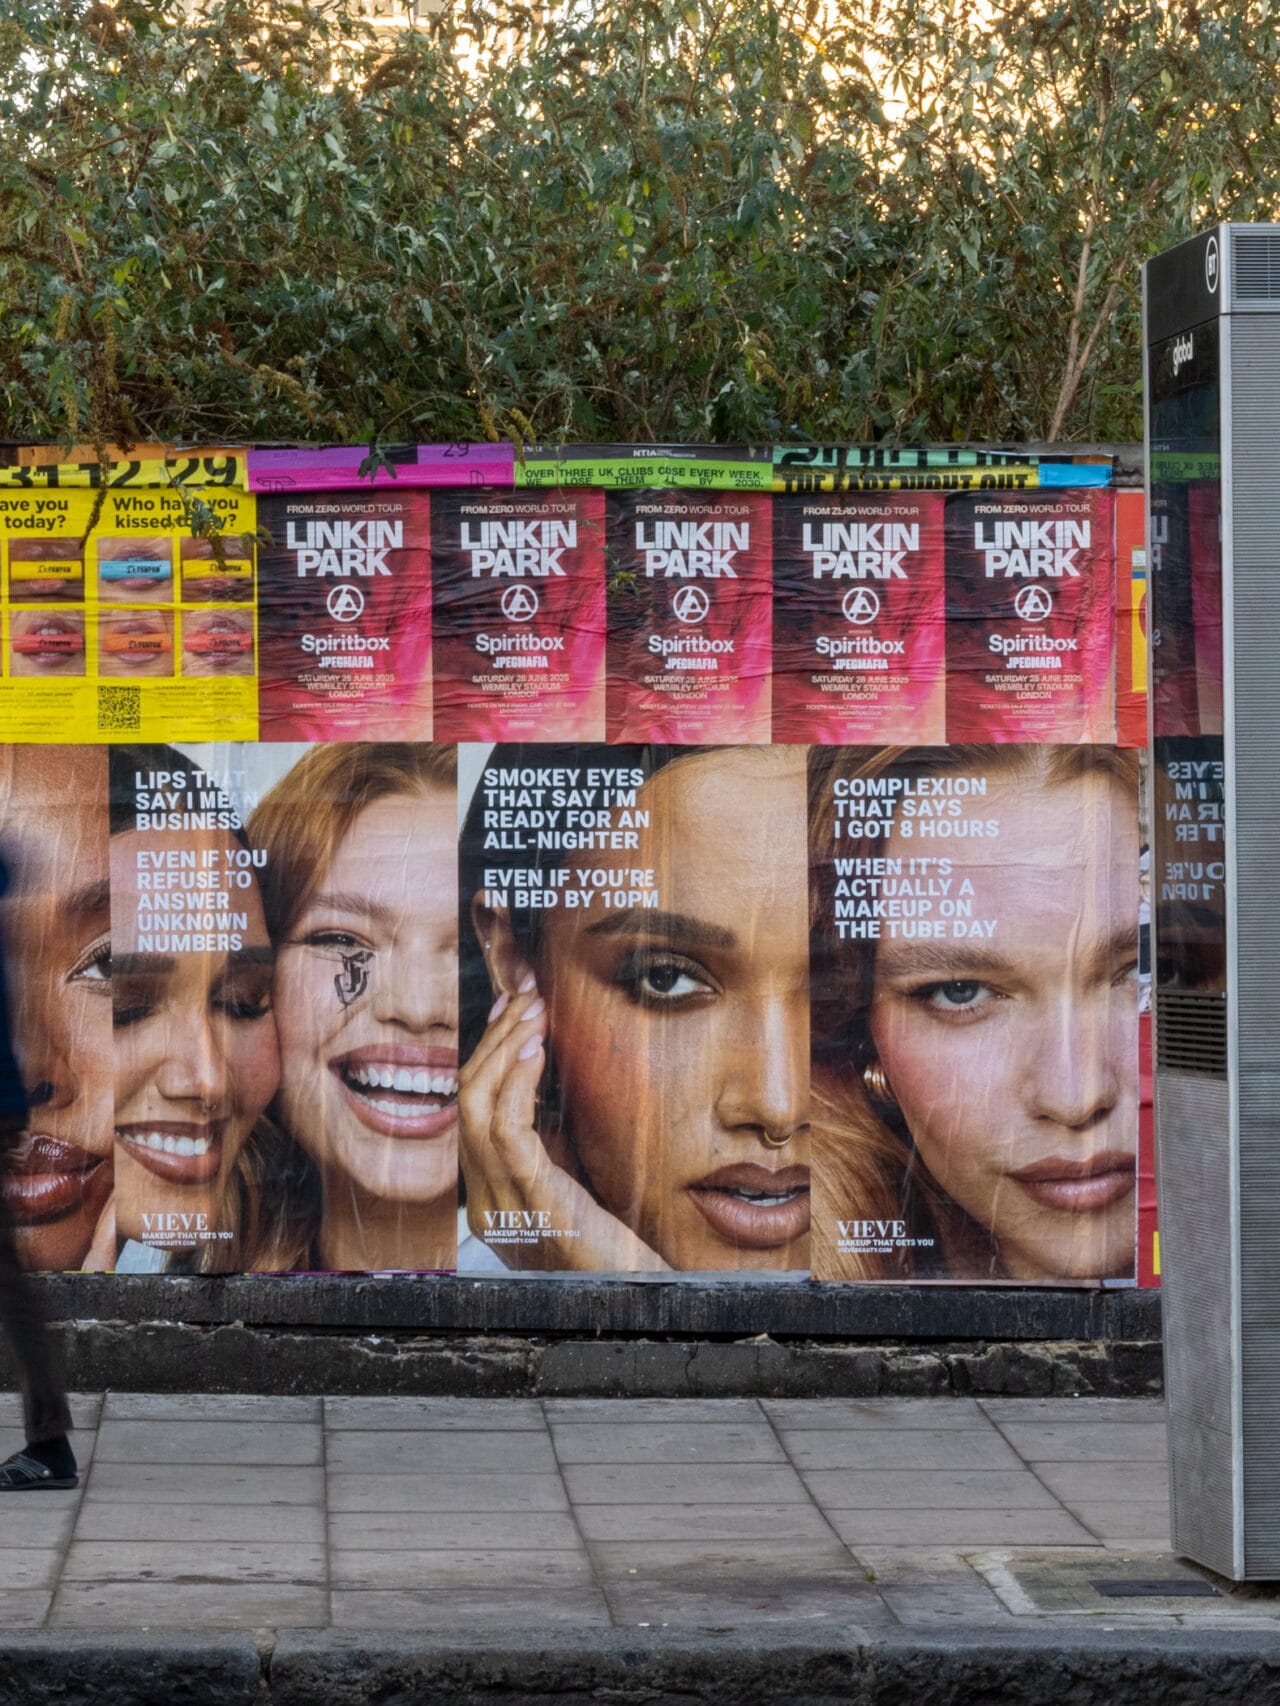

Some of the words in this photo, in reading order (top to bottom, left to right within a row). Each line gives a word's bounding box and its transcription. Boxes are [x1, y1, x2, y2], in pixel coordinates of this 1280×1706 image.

[1172, 332, 1194, 377] global
[633, 449, 657, 457] NTIA
[525, 469, 554, 479] OVER
[559, 467, 594, 477] THREE
[598, 467, 614, 477] UK
[620, 466, 654, 476] CLUBS
[689, 467, 725, 479] EVERY
[525, 477, 543, 487] WE
[564, 477, 593, 487] LOSE
[614, 476, 645, 486] THEM
[699, 477, 713, 487] BY
[35, 500, 68, 514] you
[974, 505, 1001, 514] FROM
[1002, 505, 1028, 514] ZERO
[1029, 505, 1063, 514] WORLD
[1065, 505, 1091, 514] TOUR
[5, 515, 66, 531] today?
[287, 520, 403, 550] LINKIN
[460, 520, 577, 550] LINKIN
[635, 521, 750, 551] LINKIN
[803, 522, 920, 552] LINKIN
[974, 520, 1091, 550] LINKIN
[297, 549, 393, 577] PARK
[471, 549, 566, 577] PARK
[645, 550, 739, 578] PARK
[812, 550, 909, 579] PARK
[984, 549, 1081, 578] PARK
[300, 634, 390, 655] Spiritbox
[475, 633, 565, 656] Spiritbox
[648, 635, 735, 656] Spiritbox
[815, 636, 905, 659] Spiritbox
[988, 634, 1078, 656] Spiritbox
[1006, 656, 1062, 669] JPEGMAFIA
[984, 674, 1027, 683] SATURDAY
[1040, 674, 1060, 683] JUNE
[994, 683, 1035, 691] WEMBLEY
[1037, 683, 1074, 691] STADIUM
[1016, 691, 1052, 700] LONDON
[135, 771, 186, 790] LIPS
[192, 771, 246, 790] THAT
[484, 768, 581, 788] SMOKEY
[587, 768, 645, 788] EYES
[833, 778, 988, 797] COMPLEXION
[136, 792, 182, 810] SAY
[187, 792, 193, 810] I
[199, 792, 258, 810] MEAN
[484, 789, 547, 808] THAT
[552, 789, 598, 808] SAY
[603, 789, 637, 808] I'M
[834, 799, 897, 818] THAT
[902, 799, 963, 818] SAYS
[136, 811, 242, 831] BUSINESS
[484, 810, 562, 829] READY
[567, 810, 612, 829] FOR
[617, 810, 650, 829] AN
[834, 819, 841, 839] I
[847, 819, 895, 839] GOT
[900, 819, 914, 839] 8
[920, 819, 1000, 839] HOURS
[483, 831, 640, 850] ALL-NIGHTER
[137, 850, 195, 869] EVEN
[200, 850, 219, 869] IF
[225, 850, 268, 869] YOU
[834, 858, 902, 876] WHEN
[908, 858, 953, 876] IT'S
[137, 870, 222, 890] REFUSE
[227, 870, 252, 890] TO
[484, 869, 543, 888] EVEN
[549, 869, 571, 888] IF
[576, 869, 655, 888] YOU'RE
[834, 878, 953, 897] ACTUALLY
[959, 878, 975, 897] A
[137, 891, 230, 911] ANSWER
[484, 889, 509, 909] IN
[515, 889, 558, 909] BED
[564, 889, 595, 909] BY
[601, 889, 660, 909] 10PM
[834, 899, 933, 918] MAKEUP
[938, 899, 973, 918] ON
[137, 912, 247, 931] UNKNOWN
[834, 919, 881, 939] THE
[886, 919, 946, 939] TUBE
[952, 919, 999, 939] DAY
[137, 933, 243, 952] NUMBERS
[483, 1211, 551, 1230] VIEVE
[836, 1220, 907, 1238] VIEVE
[837, 1238, 871, 1246] MAKEUP
[873, 1238, 894, 1246] THAT
[895, 1238, 916, 1246] GETS
[917, 1238, 934, 1246] YOU
